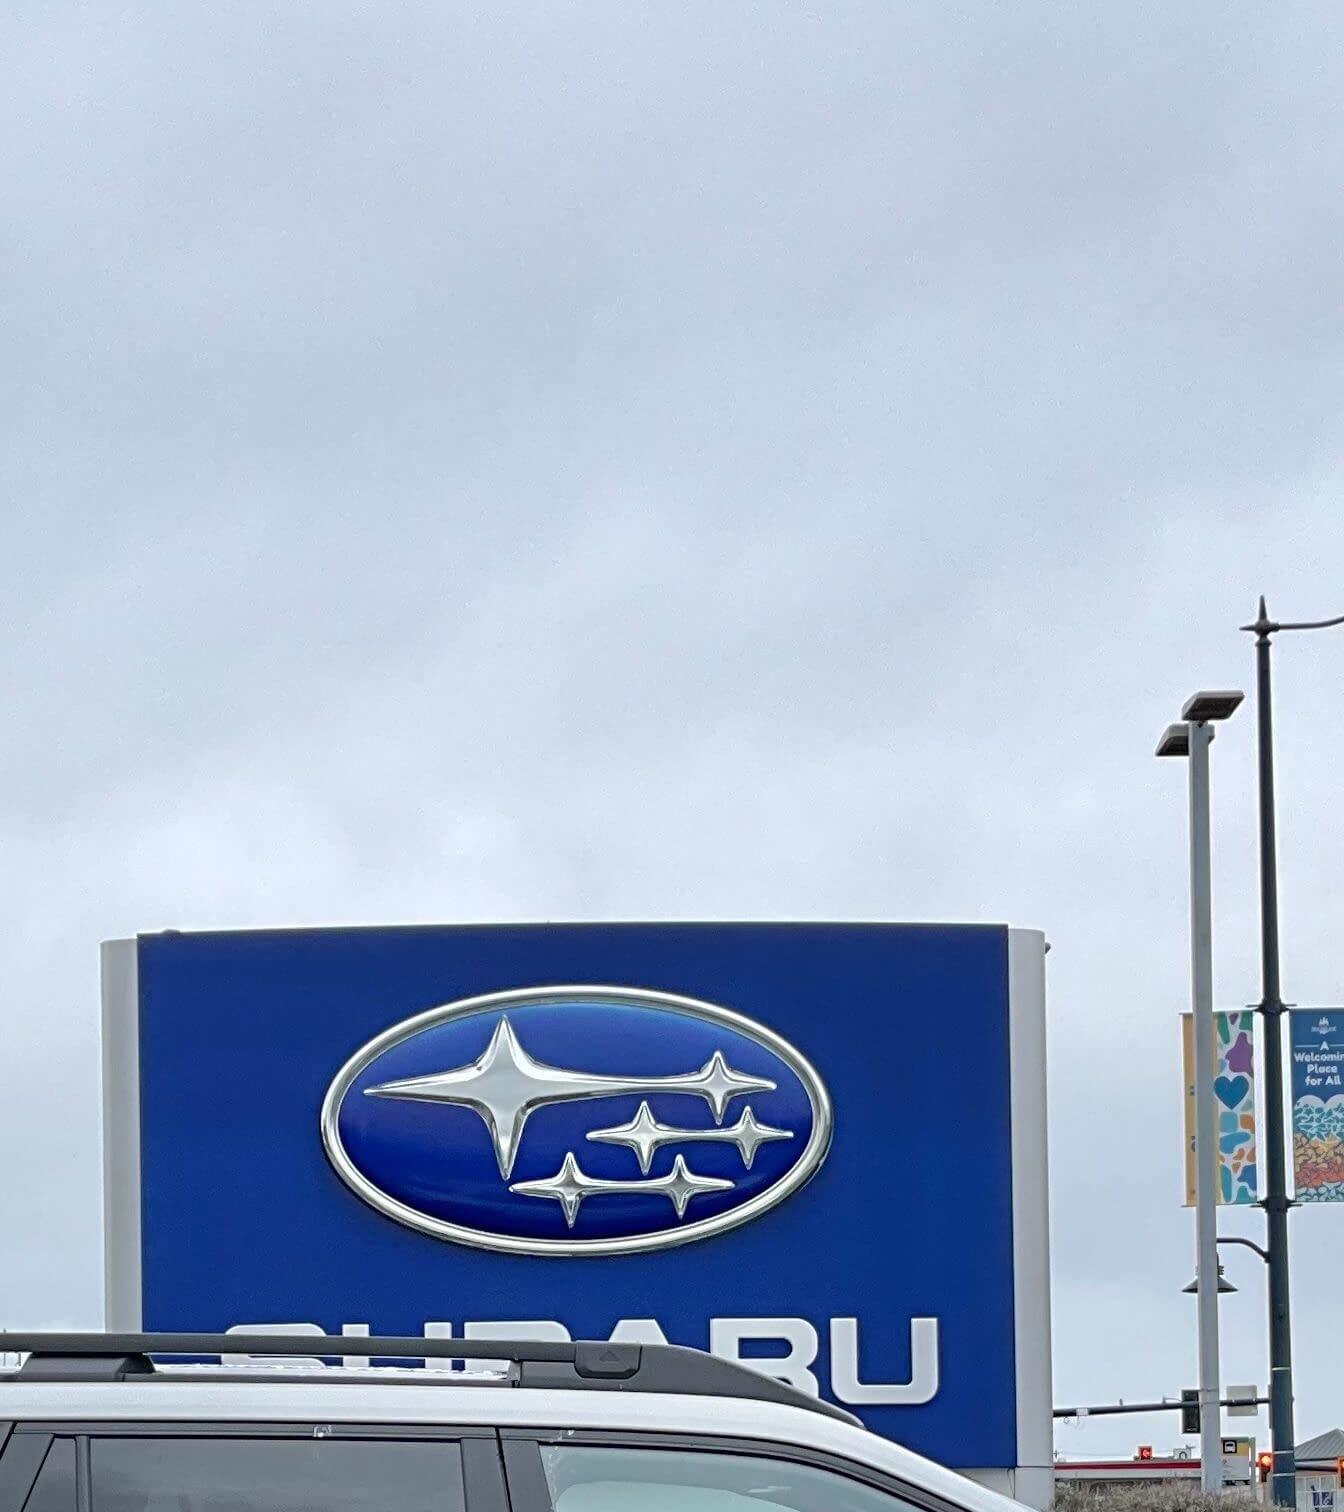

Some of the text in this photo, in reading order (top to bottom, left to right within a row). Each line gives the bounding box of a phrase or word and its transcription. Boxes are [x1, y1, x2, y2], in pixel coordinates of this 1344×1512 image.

[1320, 1041, 1329, 1050] A
[1307, 1064, 1338, 1073] Place
[1305, 1075, 1342, 1086] for All
